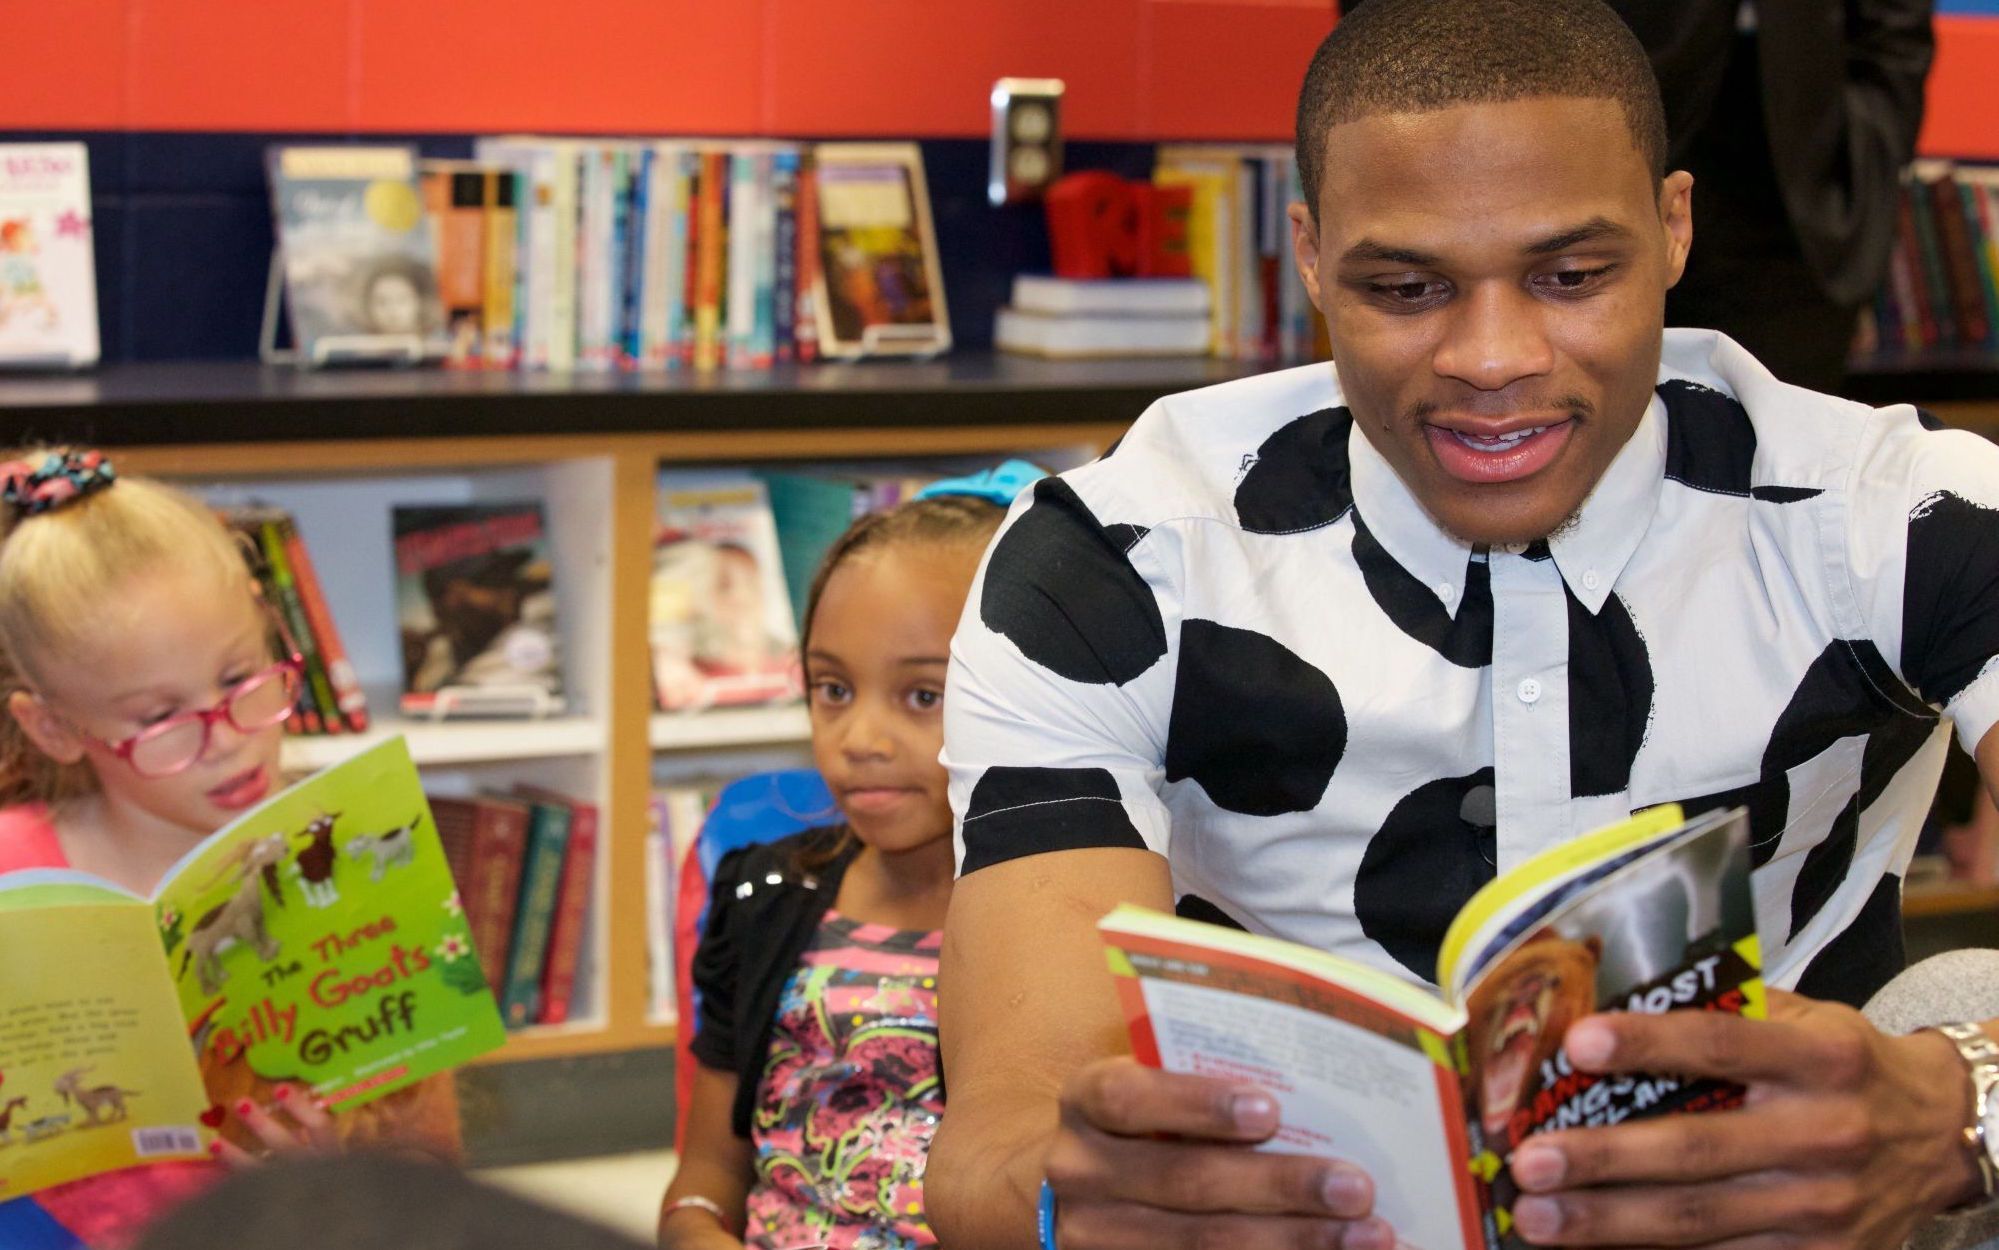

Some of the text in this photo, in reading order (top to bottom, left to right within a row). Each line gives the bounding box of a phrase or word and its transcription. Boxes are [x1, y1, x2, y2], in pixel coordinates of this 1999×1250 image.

[260, 915, 397, 987] The Three
[212, 999, 297, 1067] Billy
[308, 944, 431, 1009] Goats
[298, 989, 416, 1066] Gruff
